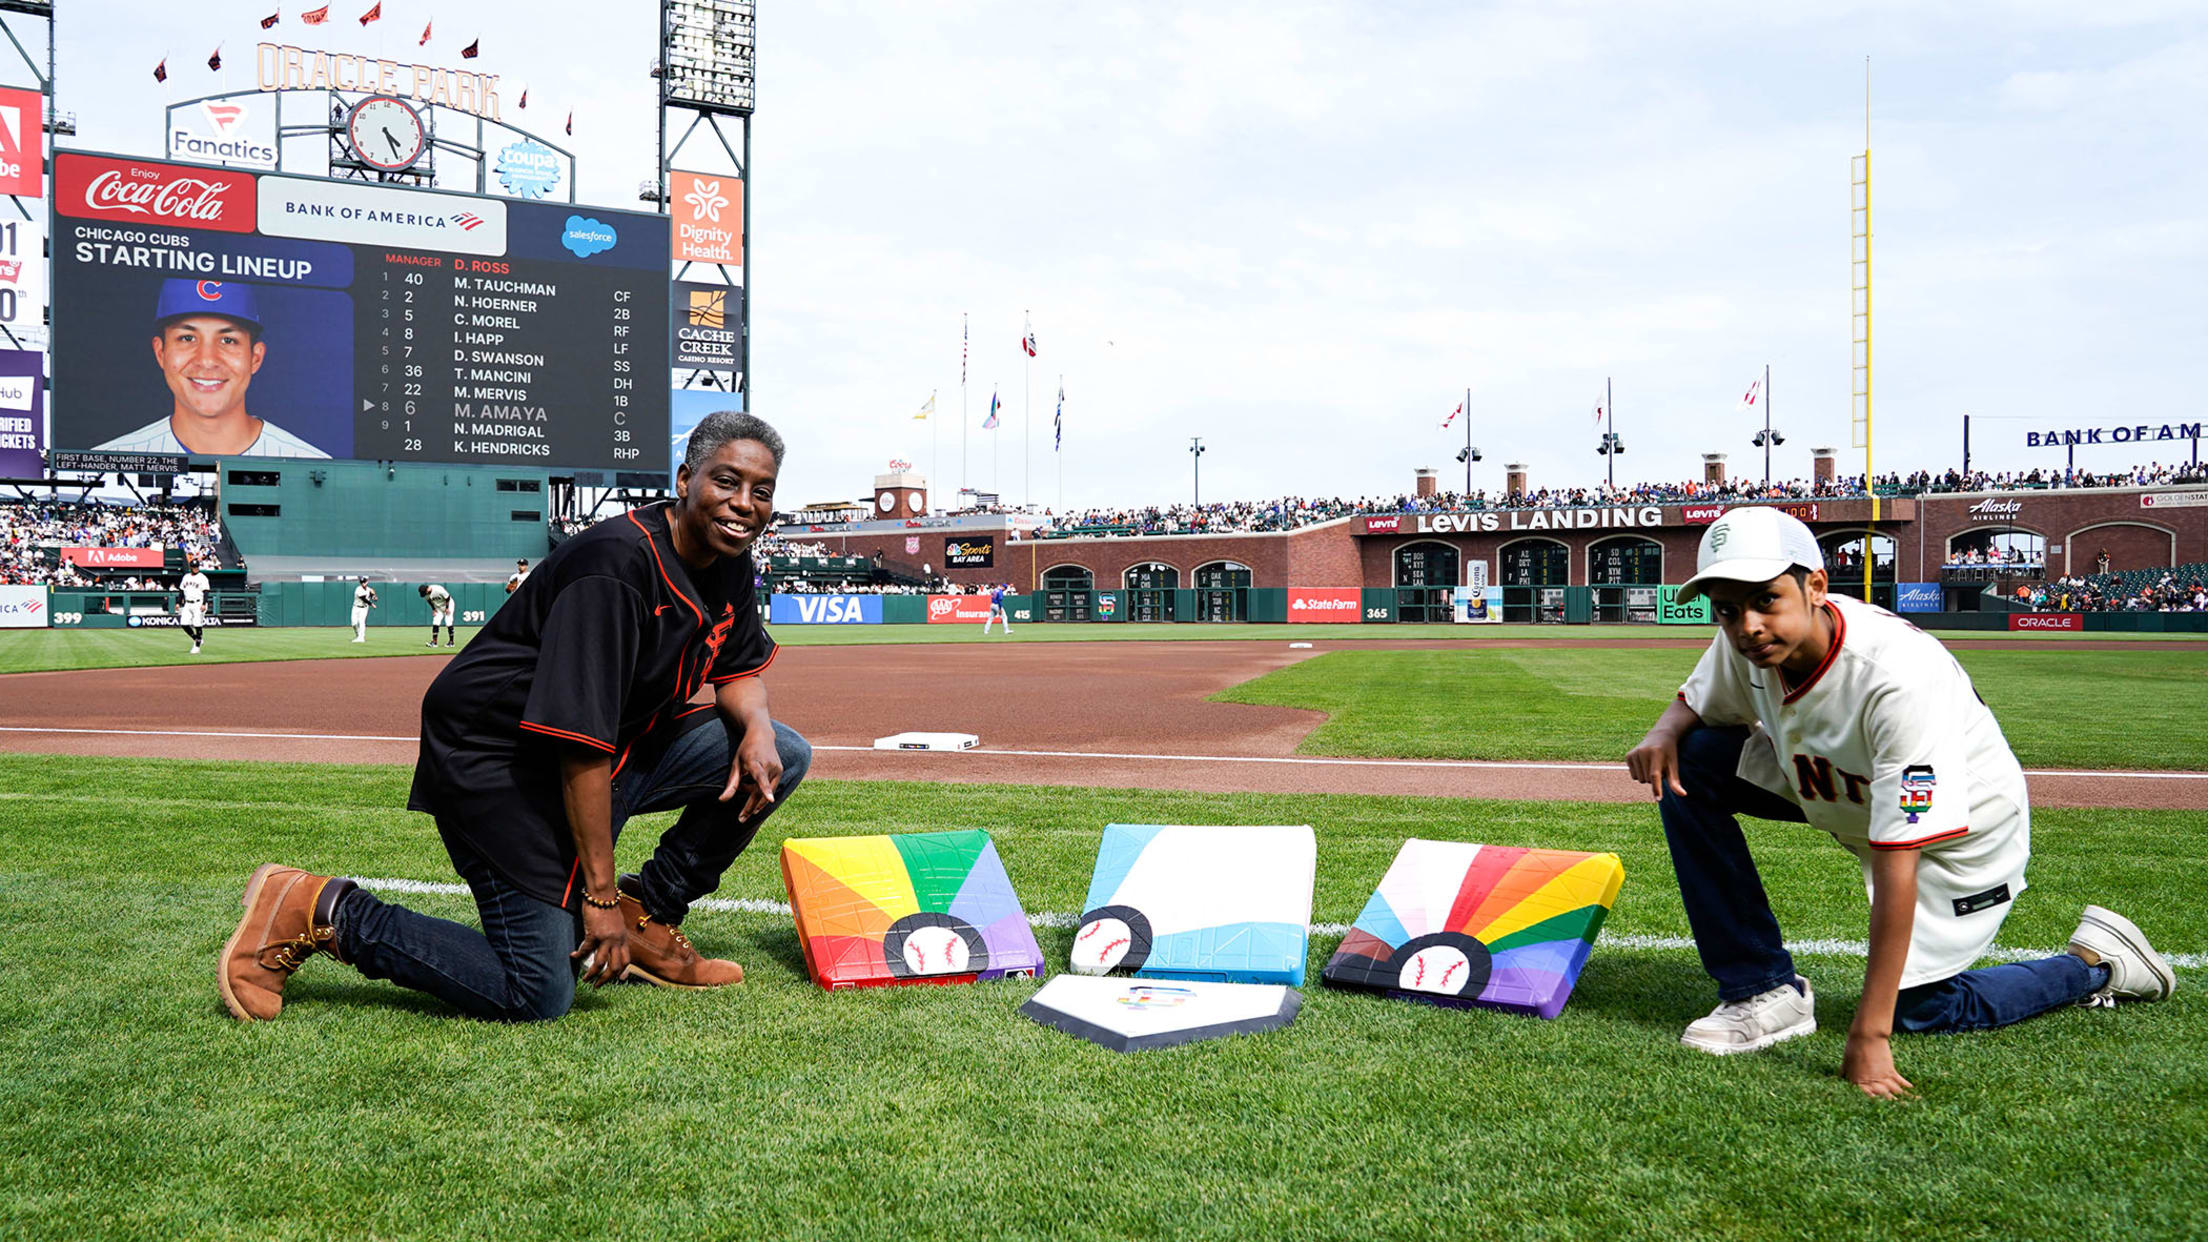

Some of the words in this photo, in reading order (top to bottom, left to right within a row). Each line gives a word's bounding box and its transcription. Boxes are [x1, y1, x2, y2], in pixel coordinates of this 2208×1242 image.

[257, 42, 397, 95] ORACLE
[411, 63, 501, 122] PARK
[175, 131, 273, 161] Fanatics
[504, 150, 555, 172] coupa
[131, 168, 160, 180] Enjoy
[85, 170, 232, 221] Coca-Cola
[286, 202, 335, 217] BANK
[340, 207, 362, 219] OF
[367, 210, 446, 228] AMERICA
[75, 226, 146, 243] CHICAGO
[149, 233, 190, 247] CUBS
[569, 230, 613, 243] salesforce
[680, 224, 733, 247] Dignity
[75, 242, 215, 273] STARTING
[222, 254, 312, 280] LINEUP
[385, 254, 442, 267] MANAGER
[454, 259, 469, 271] D.
[472, 261, 510, 275] ROSS
[384, 272, 388, 281] 1
[404, 273, 423, 285] 40
[454, 277, 471, 289] M.
[475, 278, 556, 297] TAUCHMAN
[613, 290, 631, 302] CF
[382, 290, 389, 300] 2
[404, 291, 413, 303] 2
[454, 295, 469, 307] N.
[472, 297, 537, 313] HOERNER
[613, 308, 631, 320] 2B
[382, 309, 389, 318] 3
[404, 309, 413, 321] 5
[454, 313, 469, 325] C.
[472, 315, 520, 330] MOREL
[613, 325, 630, 337] RF
[382, 328, 389, 337] 4
[404, 328, 413, 340] 8
[454, 331, 462, 343] I.
[466, 332, 504, 346] HAPP
[613, 344, 628, 355] LF
[678, 328, 735, 343] CACHE
[382, 346, 389, 356] 5
[404, 347, 413, 358] 7
[454, 350, 469, 362] D.
[472, 351, 544, 367] SWANSON
[613, 360, 630, 372] SS
[680, 341, 733, 356] CREEK
[678, 354, 706, 363] CASINO
[707, 357, 735, 365] RESORT
[382, 364, 389, 374] 6
[404, 365, 423, 377] 36
[454, 368, 467, 380] T.
[471, 369, 531, 384] MANCINI
[613, 378, 633, 390] DH
[382, 383, 389, 392] 7
[404, 383, 421, 396] 22
[454, 386, 471, 398] M.
[474, 387, 527, 401] MERVIS
[614, 395, 629, 407] 1B
[382, 401, 389, 411] 8
[404, 401, 416, 415] 6
[454, 403, 475, 418] M.
[480, 405, 548, 422] AMAYA
[613, 411, 626, 425] C
[382, 420, 389, 430] 9
[404, 420, 411, 432] 1
[454, 423, 468, 435] N.
[472, 423, 545, 438] MADRIGAL
[613, 430, 631, 442] 3B
[2027, 428, 2102, 447] BANK
[2112, 426, 2148, 442] OF
[2157, 423, 2201, 441] AM
[56, 453, 80, 461] FIRST
[82, 455, 107, 463] BASE,
[404, 439, 422, 451] 28
[454, 441, 468, 453] K.
[471, 441, 551, 456] HENDRICKS
[613, 448, 640, 460] RHP
[56, 462, 118, 471] LEFT-HANDER,
[1969, 498, 2023, 513] Alaska
[1511, 506, 1662, 530] LANDING
[107, 553, 137, 562] Adobe
[960, 543, 993, 556] Sports
[966, 555, 985, 563] AREA
[1608, 557, 1621, 565] COL
[1472, 566, 1480, 598] Corona
[1899, 588, 1944, 602] Alaska
[54, 612, 82, 624] 399
[463, 611, 484, 622] 391
[792, 596, 863, 622] VISA
[1014, 610, 1030, 619] 415
[1366, 608, 1387, 618] 365
[1664, 605, 1704, 618] Eats
[142, 616, 179, 626] KONICA
[2017, 618, 2071, 627] ORACLE
